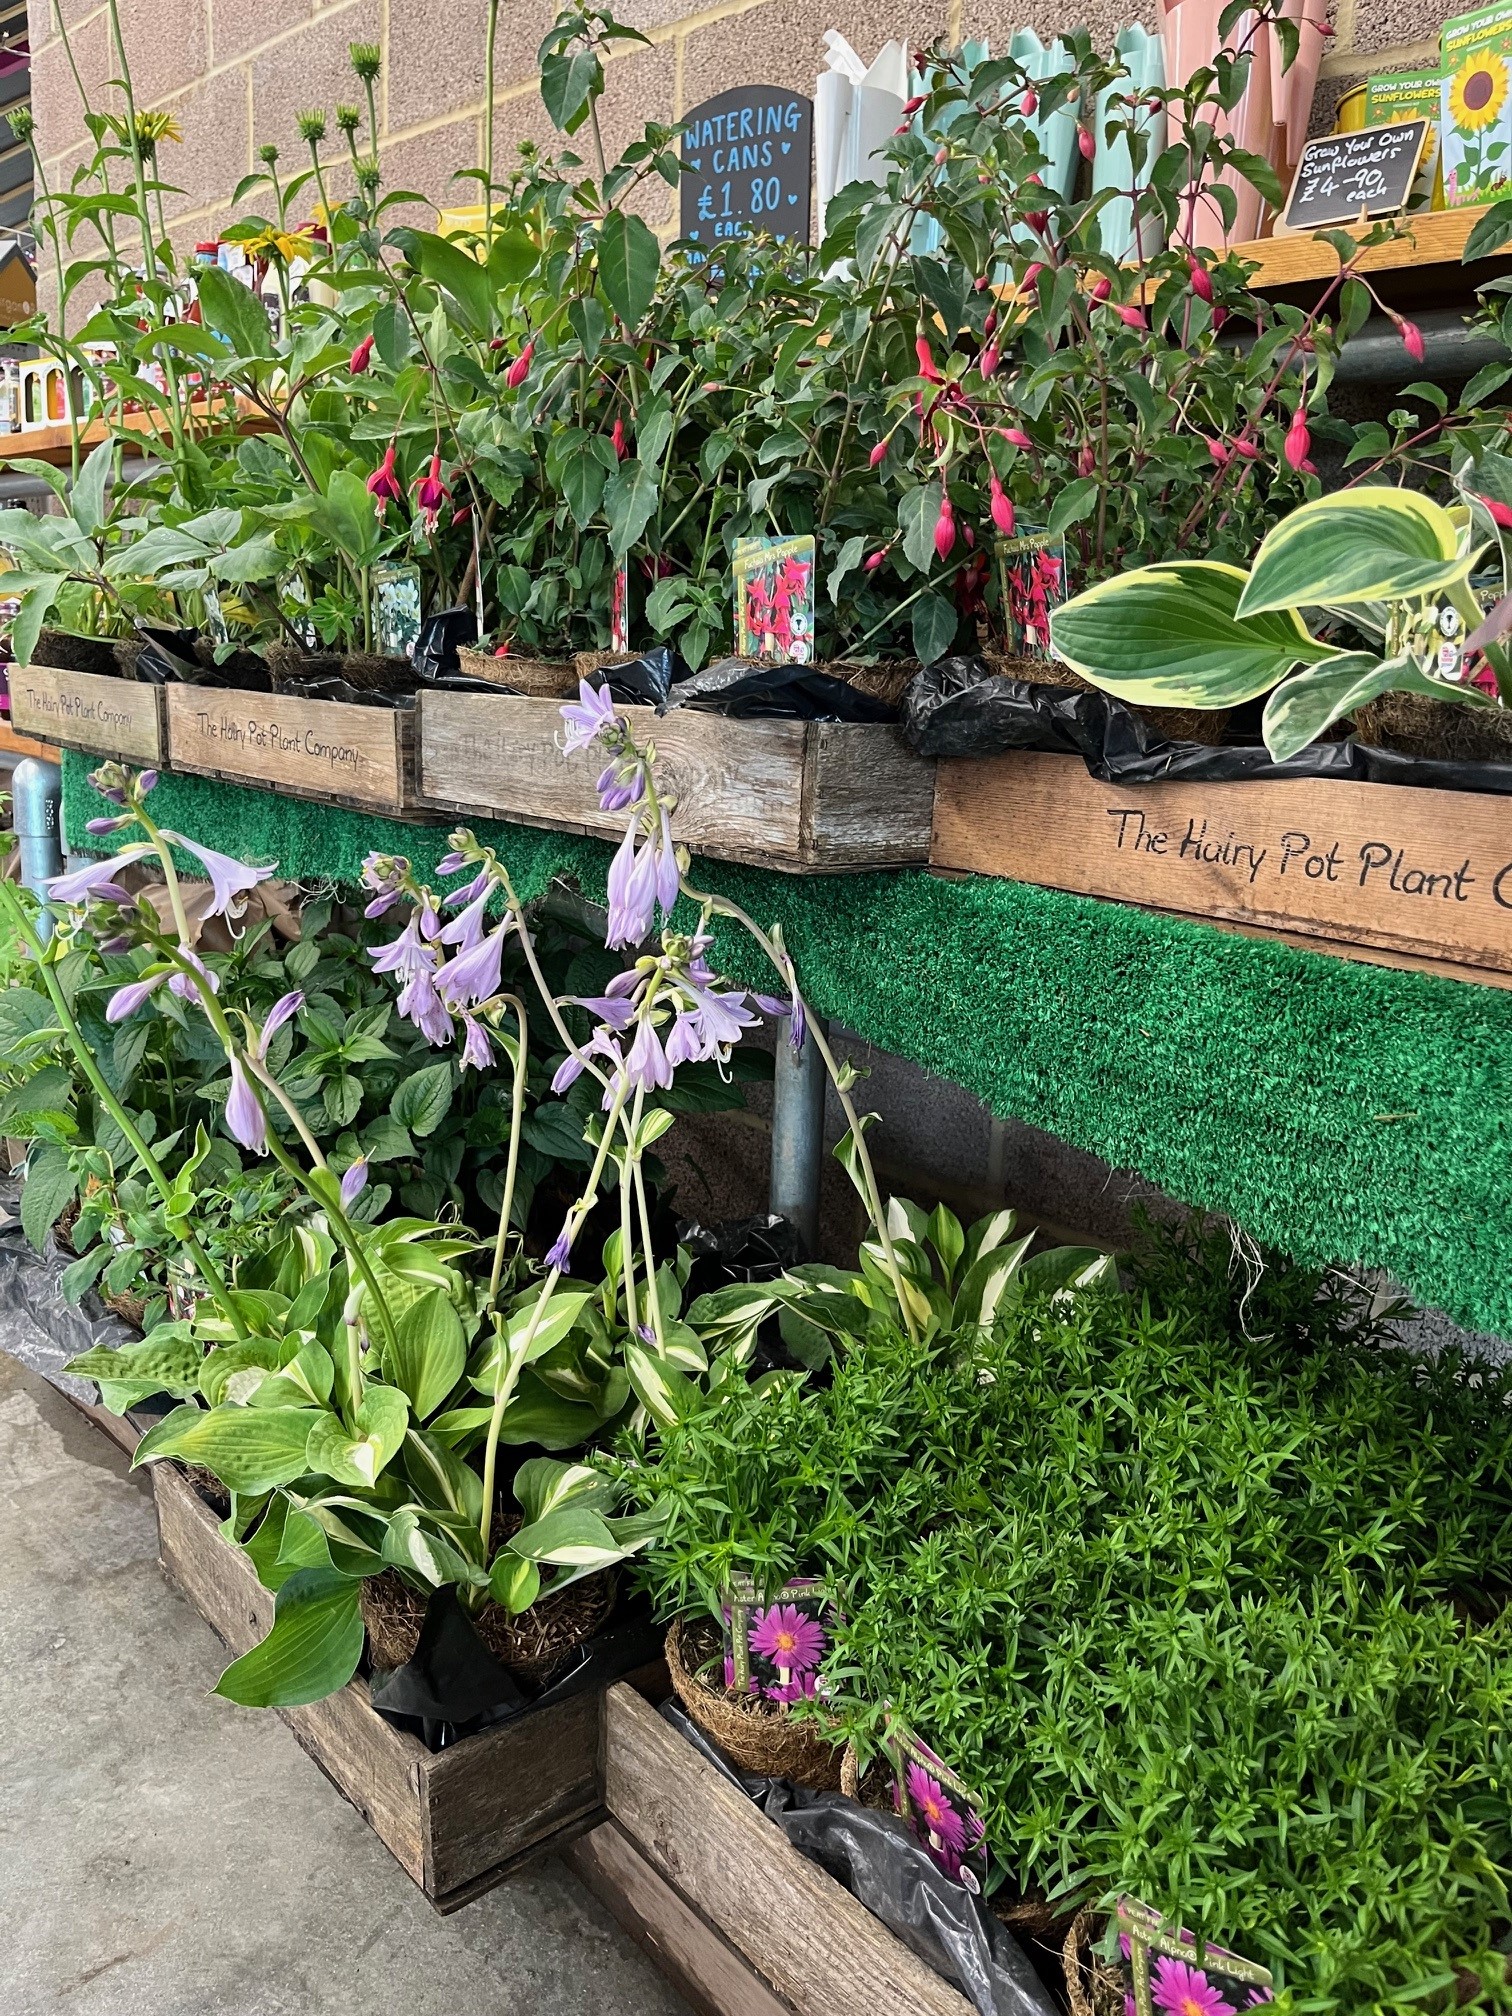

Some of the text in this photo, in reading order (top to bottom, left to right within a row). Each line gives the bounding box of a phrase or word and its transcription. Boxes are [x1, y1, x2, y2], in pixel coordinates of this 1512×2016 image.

[1446, 24, 1470, 40] GROW
[1471, 15, 1494, 30] YOUR
[1371, 83, 1397, 93] GROW
[1399, 80, 1423, 90] YOUR
[1371, 88, 1441, 104] SUNFLOWERS
[685, 102, 802, 150] WATERING
[712, 140, 773, 174] CANS
[1302, 147, 1401, 178] Sunflowers
[1304, 130, 1414, 162] Grow Your Own
[697, 176, 780, 221] £1.80
[1346, 178, 1388, 203] each
[27, 689, 133, 733] The Hairy Pot Plant Company
[198, 712, 360, 771] The Hairy Pot Plant Company
[1106, 809, 1168, 854] The
[1179, 818, 1266, 883] Hairy
[1280, 832, 1344, 882] Pot
[1359, 841, 1476, 901] Plant
[791, 1588, 813, 1600] Pink
[1132, 1924, 1152, 1942] Aste
[1227, 1962, 1255, 1982] Light
